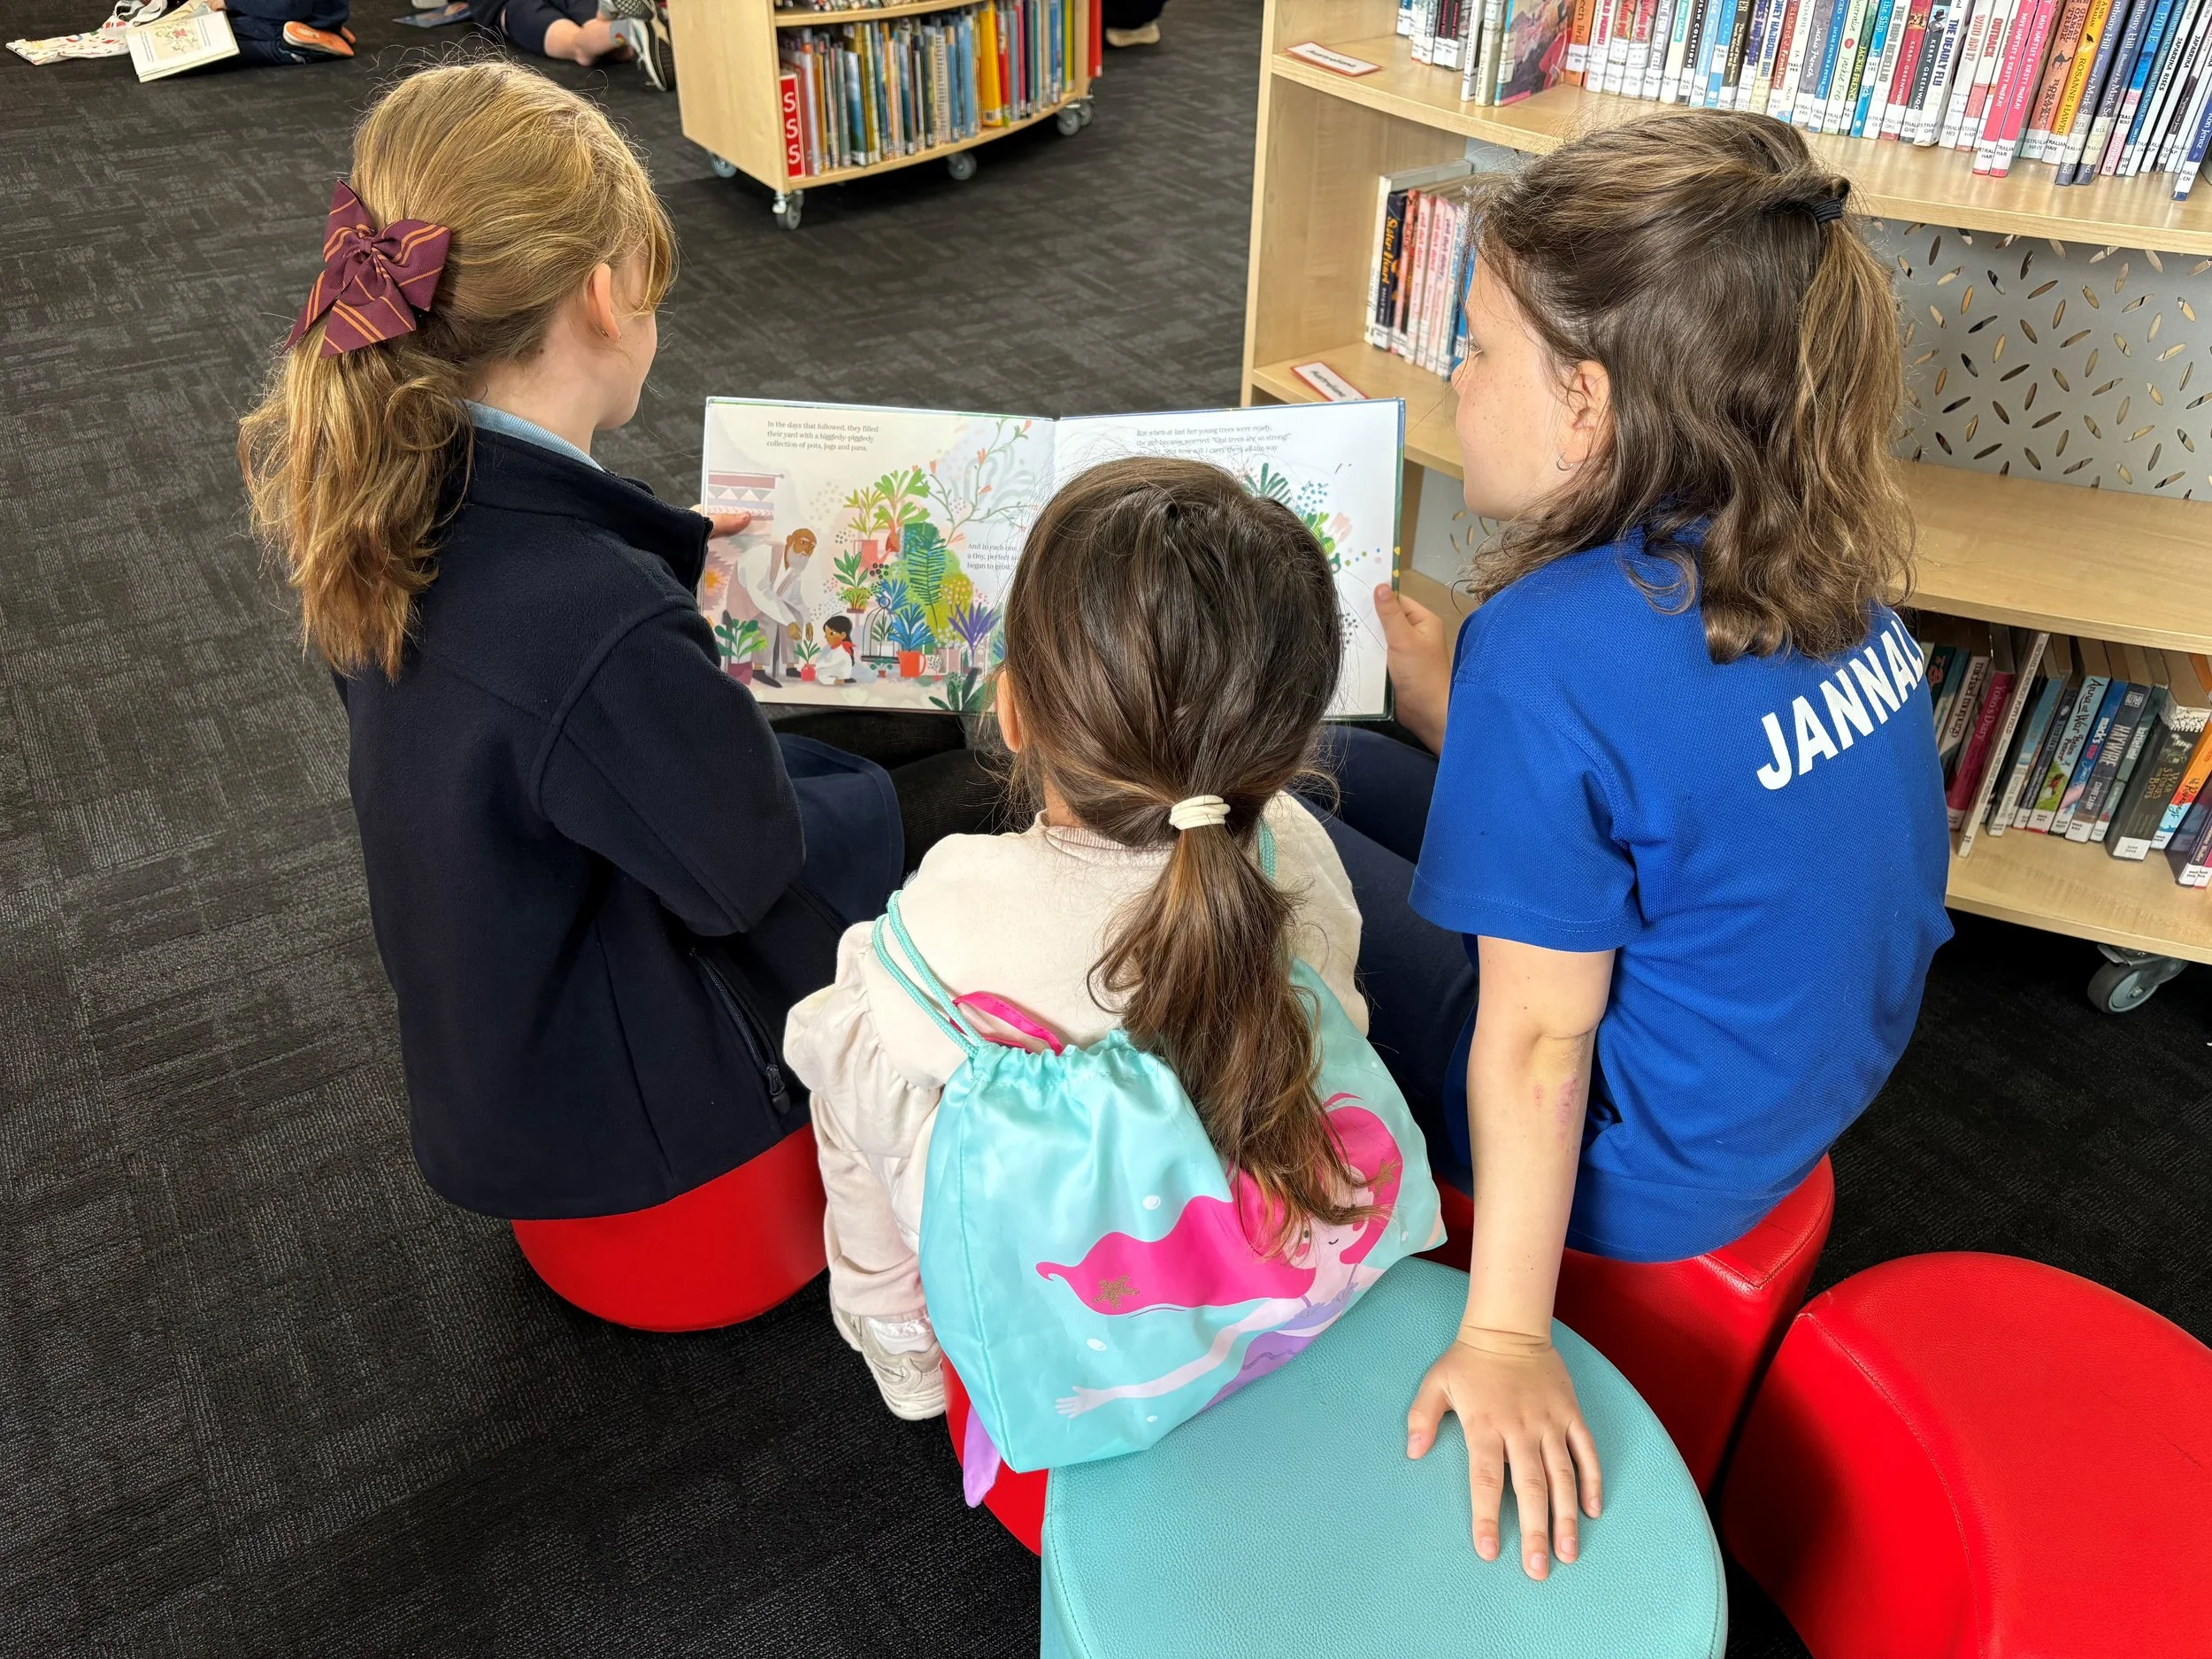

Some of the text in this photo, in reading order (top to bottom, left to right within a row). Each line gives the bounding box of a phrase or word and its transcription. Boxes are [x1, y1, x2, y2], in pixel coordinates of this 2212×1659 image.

[1656, 16, 1668, 33] FOR
[1786, 7, 1798, 37] Richard
[1876, 0, 1892, 33] the Ship
[1893, 5, 1906, 22] THE
[1970, 14, 1986, 36] WHO
[2020, 12, 2029, 28] DAVE
[2038, 14, 2047, 29] DAVE
[2059, 7, 2075, 42] TREK
[2065, 8, 2080, 42] CAMEL
[2071, 8, 2086, 43] GREAT
[1984, 17, 2004, 58] OUTBACK
[2150, 12, 2167, 43] POLE
[1763, 21, 1780, 60] HARBOUR
[1806, 24, 1824, 79] Jackie French
[1906, 40, 1916, 63] KERRY
[1926, 39, 1937, 64] KERRY
[1932, 19, 1960, 87] THE DEADLY FLU
[1967, 35, 1980, 52] AM
[2012, 27, 2026, 55] HARTLEY
[2030, 28, 2043, 57] HARTLEY
[2101, 33, 2113, 50] Hill
[2125, 32, 2138, 50] Hill
[2183, 35, 2201, 69] JAPARRIKA
[1855, 45, 1867, 73] JACKIE
[2159, 36, 2184, 91] JAPARRIKA RISES
[2001, 61, 2015, 84] KIRSTY
[2020, 63, 2032, 85] KIRSTY
[2115, 76, 2121, 85] by
[1995, 84, 2009, 108] MURRAY
[2013, 85, 2026, 110] MURRAY
[2056, 58, 2087, 136] ROSANNE HAWKE
[2081, 86, 2095, 108] Mark
[2106, 85, 2121, 108] Mark
[783, 91, 801, 165] S S S
[2196, 128, 2210, 150] Jensz
[1381, 215, 1398, 284] Sister Heart
[782, 431, 798, 440] yard
[819, 433, 875, 443] higgledy-piggledy
[817, 423, 847, 432] followed,
[847, 424, 861, 433] they
[823, 442, 837, 451] jugs
[967, 562, 987, 571] began
[1950, 662, 1985, 740] michael morpurgo
[2083, 678, 2106, 706] Anna
[1976, 685, 2008, 741] Yoko's Diary
[2071, 711, 2092, 735] War
[2068, 733, 2085, 757] Helen
[2098, 724, 2131, 768] HAYWIRE
